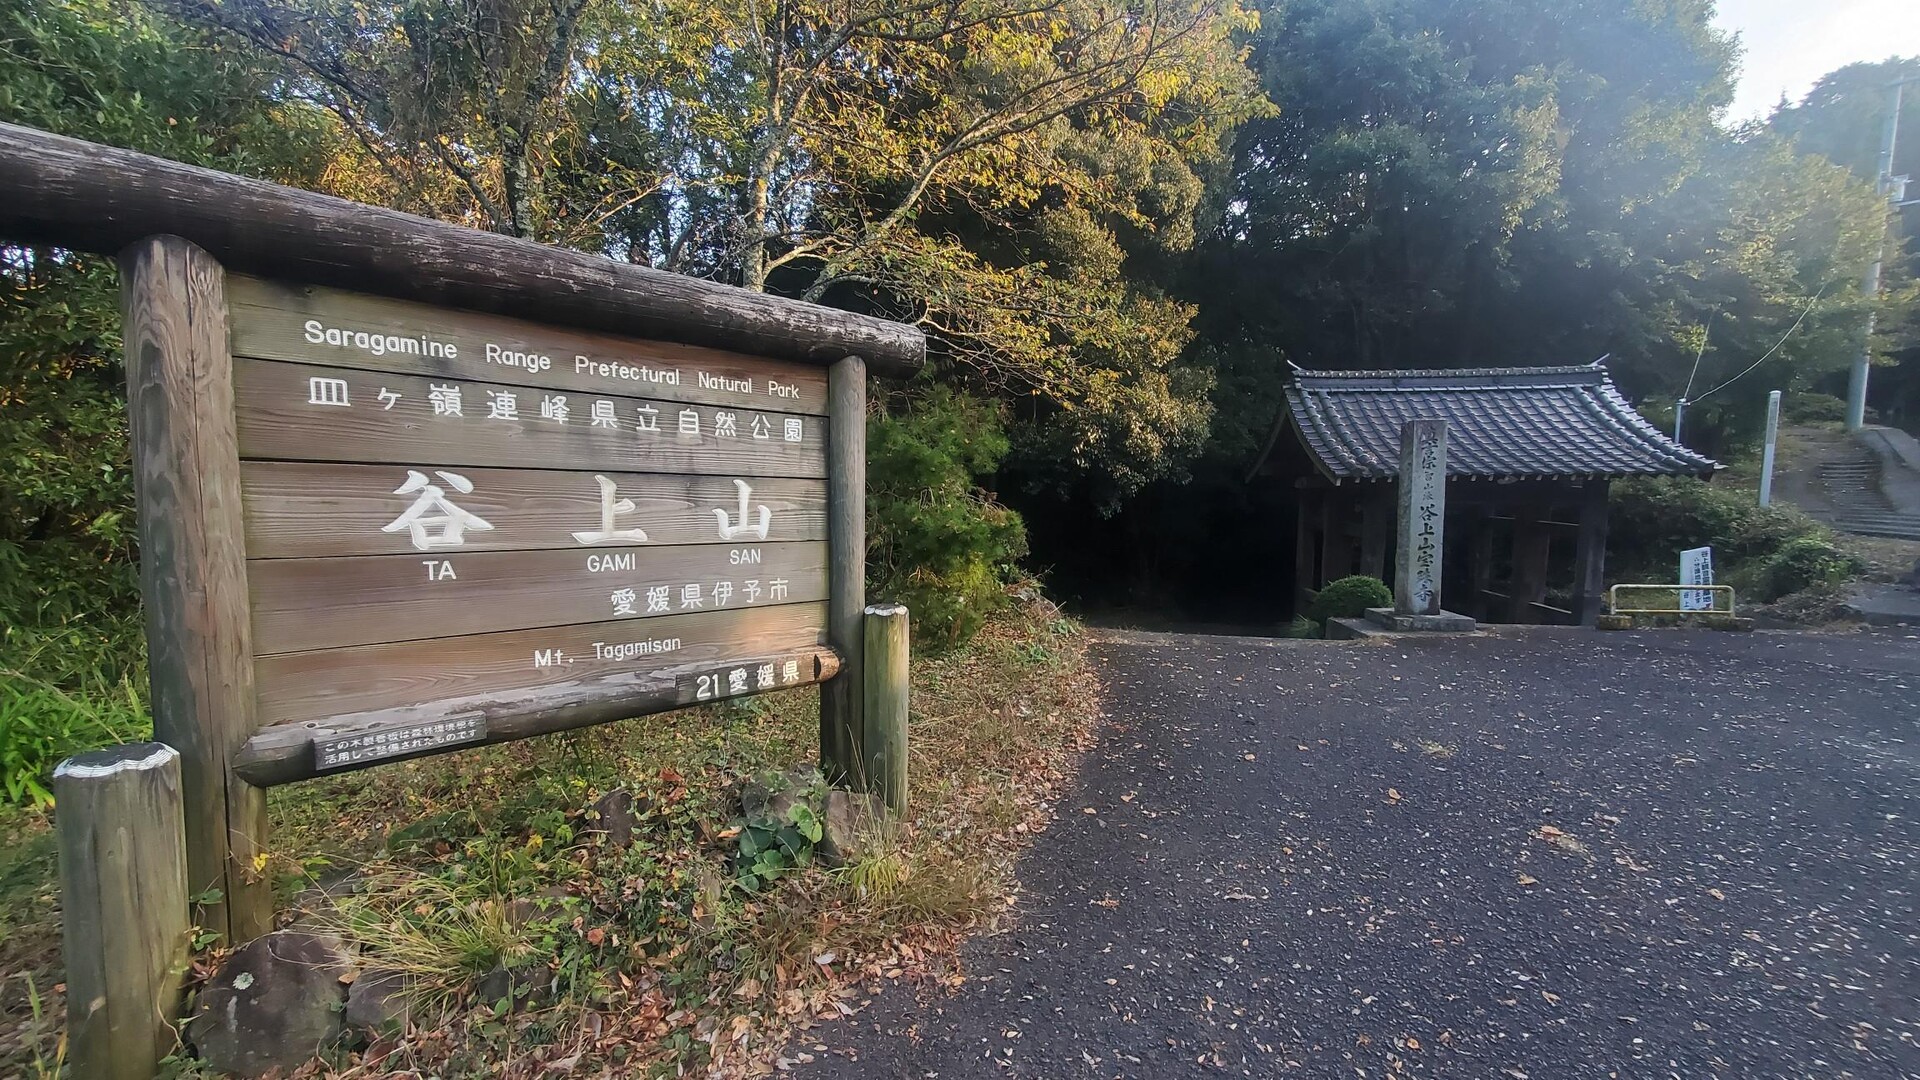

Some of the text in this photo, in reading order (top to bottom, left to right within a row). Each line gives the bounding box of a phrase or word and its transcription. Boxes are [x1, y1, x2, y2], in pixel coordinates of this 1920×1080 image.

[305, 320, 800, 399] Saragamine Range Prefectural Natural Park
[381, 469, 772, 551] 谷上山
[423, 548, 761, 581] TA GAMI SAN
[611, 578, 789, 616] 愛媛県伊予市
[534, 636, 681, 668] Mt. Tagamisan
[325, 728, 477, 765] 活用して整備されたものです
